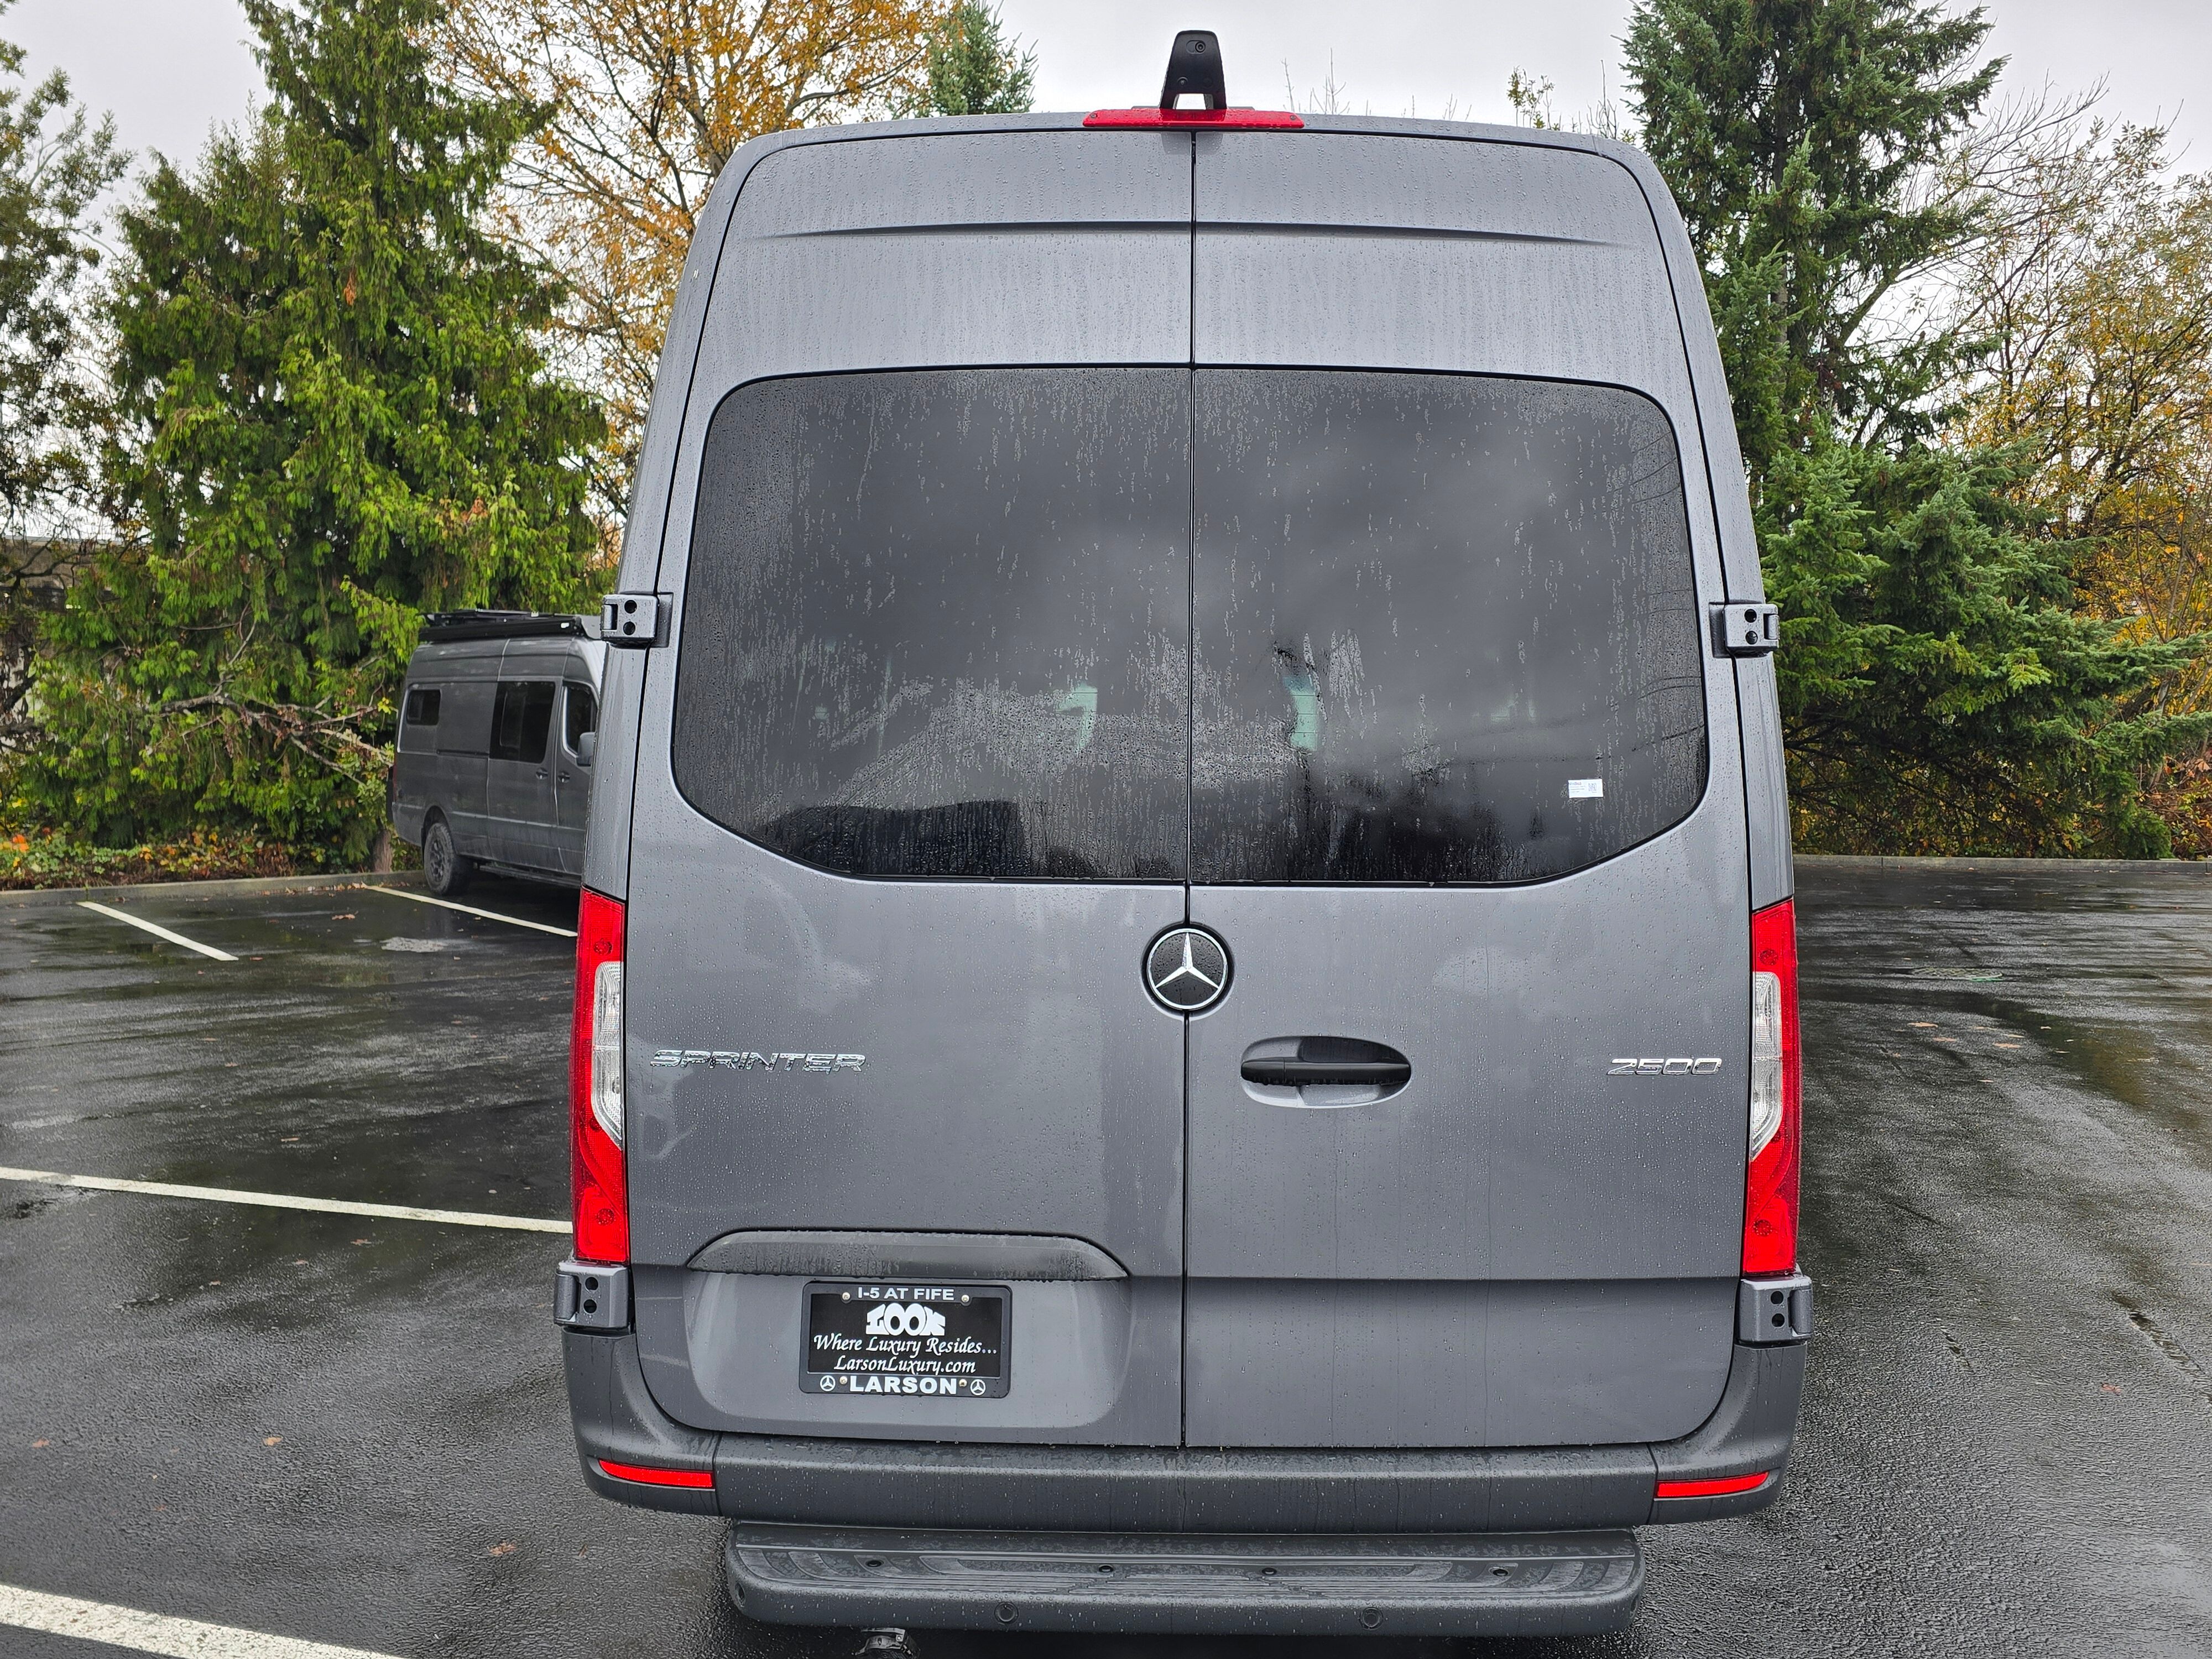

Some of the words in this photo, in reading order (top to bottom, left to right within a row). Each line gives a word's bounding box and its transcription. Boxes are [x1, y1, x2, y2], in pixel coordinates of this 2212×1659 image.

[650, 1050, 867, 1074] SPRINTER
[1606, 1057, 1722, 1076] 2500
[858, 1287, 880, 1299] I-5
[884, 1287, 909, 1300] AT
[914, 1288, 955, 1301] FIFE
[813, 1333, 863, 1352] Where
[866, 1337, 922, 1358] Luxury
[925, 1337, 997, 1354] Resides...
[834, 1355, 976, 1375] LarsonLuxury.com
[849, 1376, 957, 1395] LARSON
